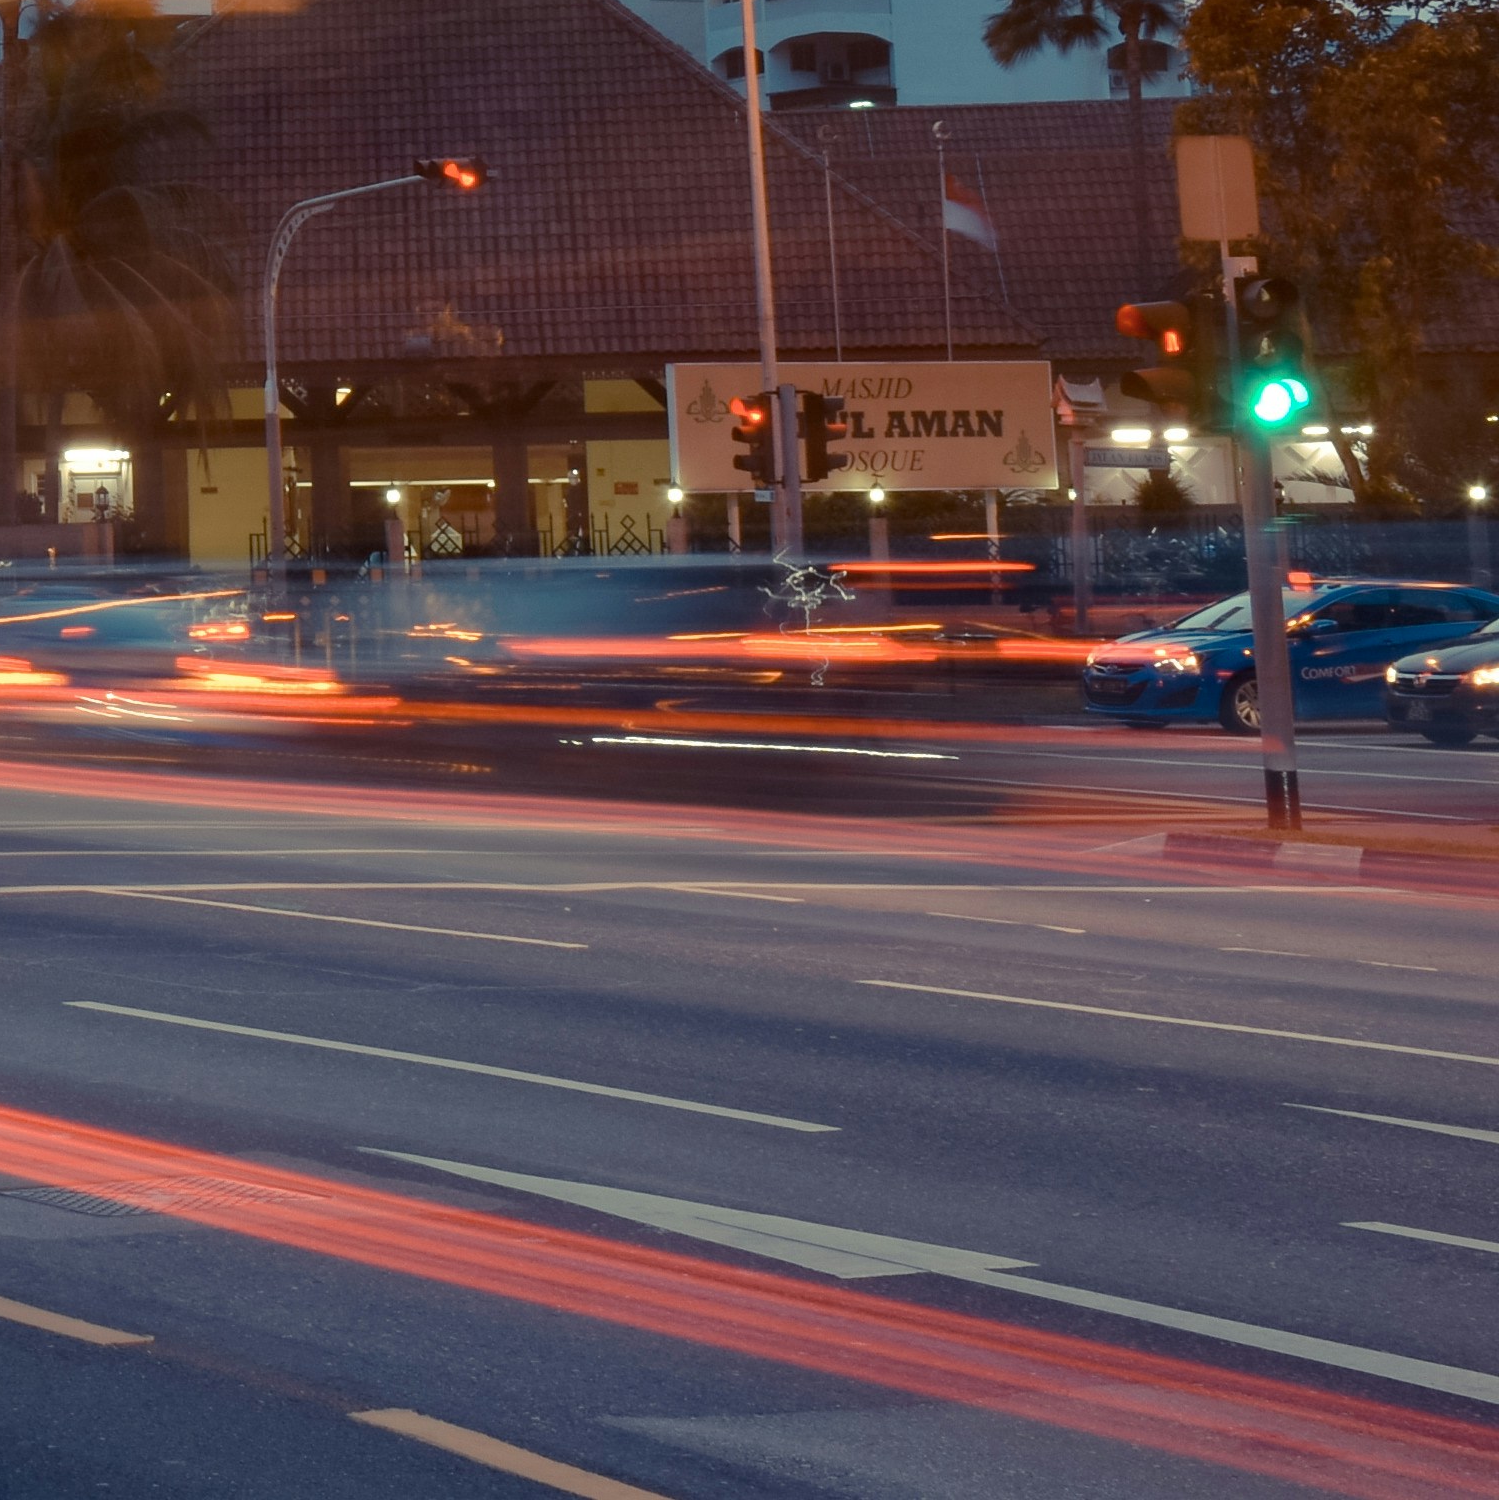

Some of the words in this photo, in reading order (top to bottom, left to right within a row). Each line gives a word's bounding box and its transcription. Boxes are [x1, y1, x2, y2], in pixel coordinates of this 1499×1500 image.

[822, 377, 913, 399] MASJID
[885, 410, 1003, 438] AMAN
[836, 449, 924, 473] OSQUE
